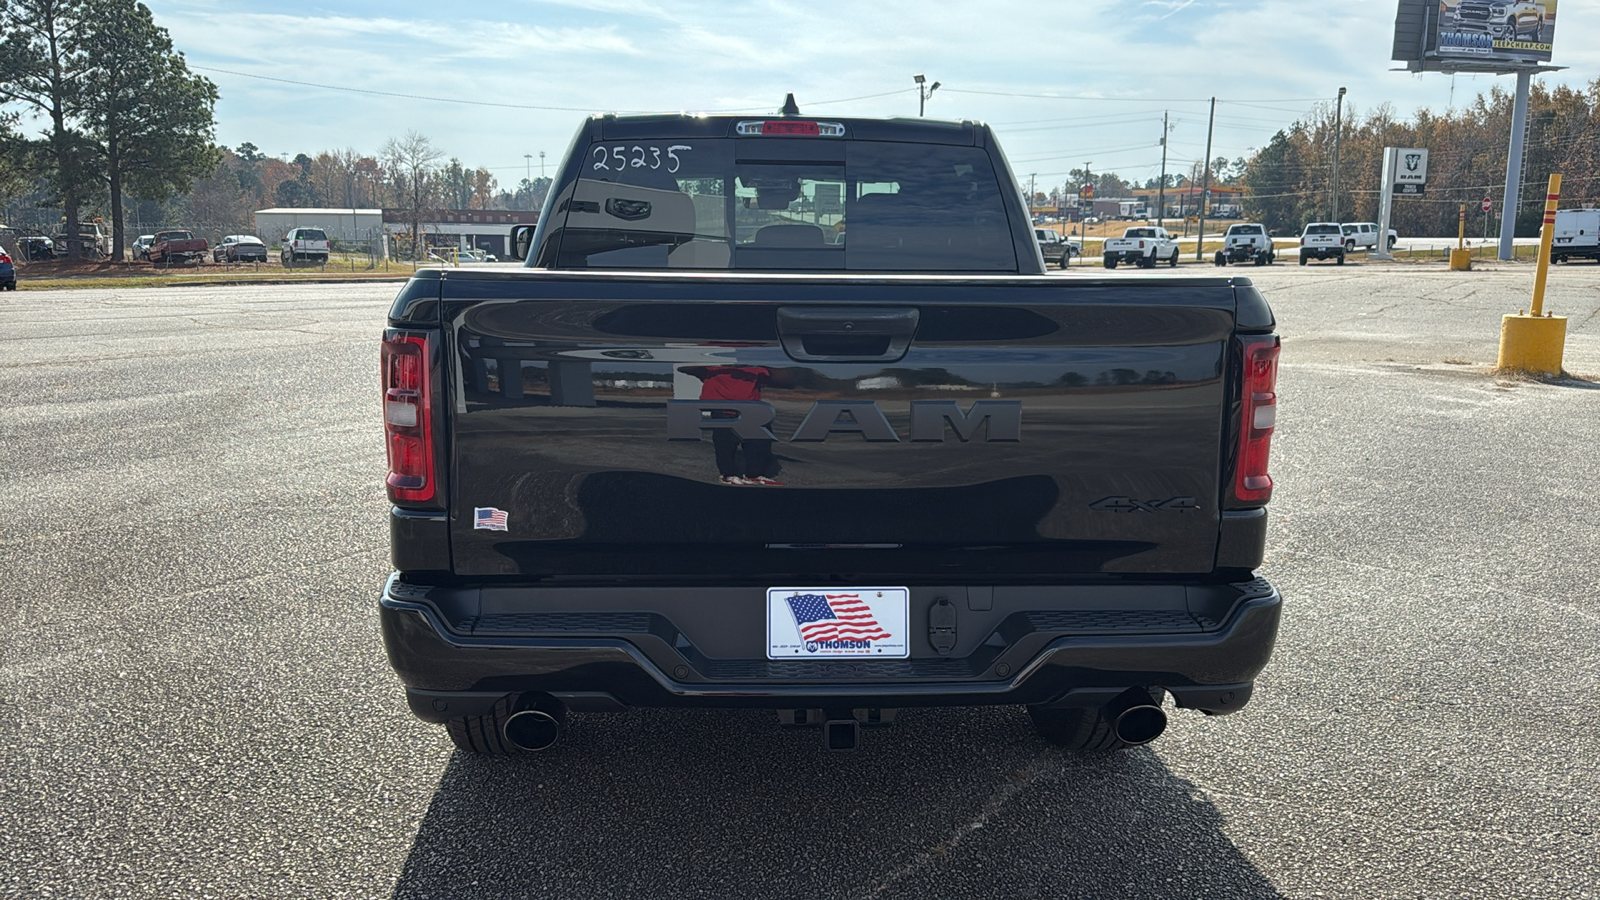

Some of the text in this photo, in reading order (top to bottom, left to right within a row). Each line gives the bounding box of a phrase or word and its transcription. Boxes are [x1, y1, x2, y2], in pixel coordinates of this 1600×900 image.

[1440, 32, 1493, 48] THOMSON
[1493, 41, 1551, 51] JEEPCHEAP.COM
[593, 145, 692, 173] 25235
[667, 400, 1022, 442] RAM
[819, 640, 871, 649] THOMSON
